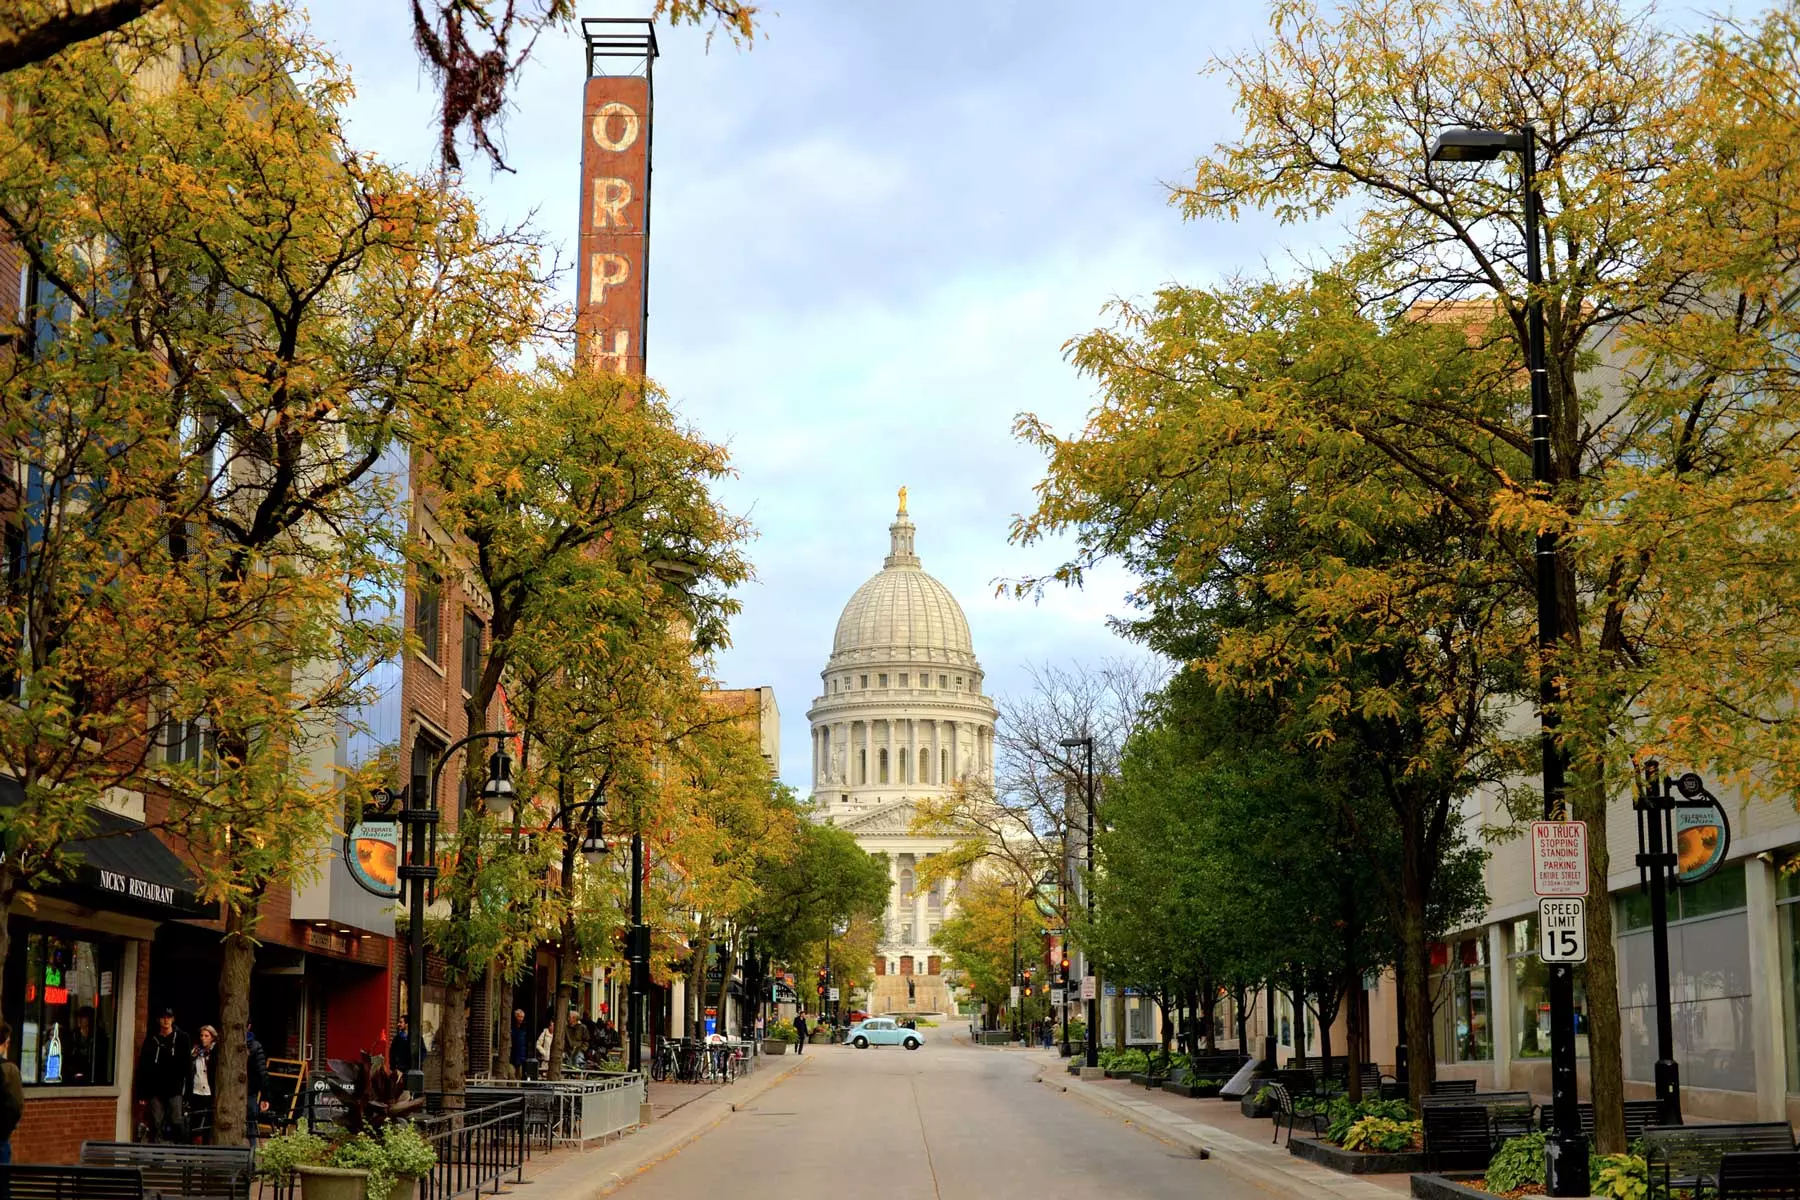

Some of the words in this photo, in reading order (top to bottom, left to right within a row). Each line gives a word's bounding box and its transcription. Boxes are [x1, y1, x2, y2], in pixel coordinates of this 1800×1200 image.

[1537, 826, 1549, 838] NO
[1553, 826, 1580, 838] TRUCK
[1540, 839, 1578, 848] STOPPING
[1541, 848, 1579, 857] STANDING
[1543, 861, 1576, 870] PARKING
[100, 869, 126, 892] NICK'S
[129, 878, 174, 904] RESTAURANT
[1544, 904, 1580, 915] SPEED
[1547, 916, 1576, 927] LIMIT
[1548, 931, 1578, 956] 15
